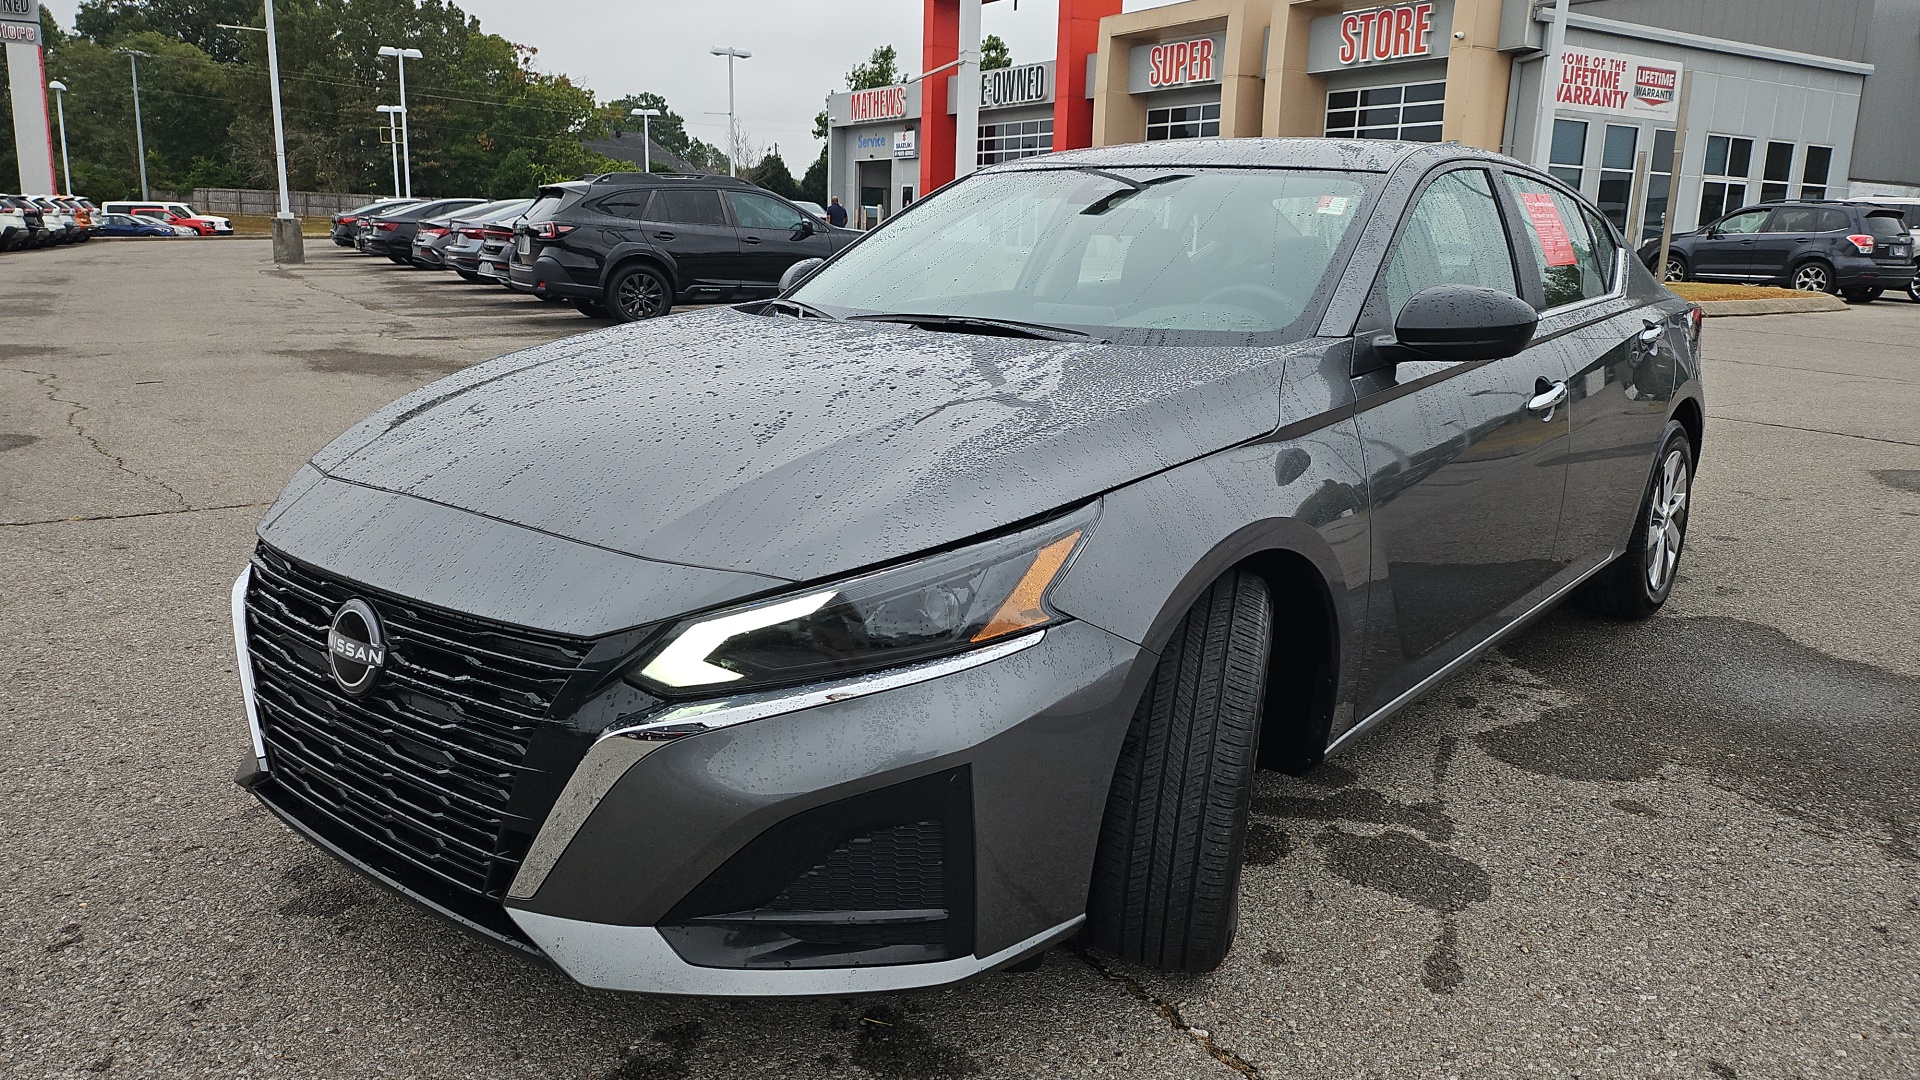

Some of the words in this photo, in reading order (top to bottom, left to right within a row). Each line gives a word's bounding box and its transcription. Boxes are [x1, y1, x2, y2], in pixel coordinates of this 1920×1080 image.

[0, 0, 30, 14] NED
[0, 22, 35, 40] tore
[1339, 3, 1432, 64] STORE
[1149, 39, 1213, 87] SUPER
[1593, 56, 1606, 69] OF
[1610, 59, 1626, 72] THE
[1562, 65, 1620, 90] LIFETIME
[1637, 69, 1675, 87] LIFETIME
[1636, 86, 1673, 100] WARRANTY
[850, 86, 904, 122] MATHEWS
[858, 133, 886, 148] Service
[329, 632, 382, 665] NISSAN
